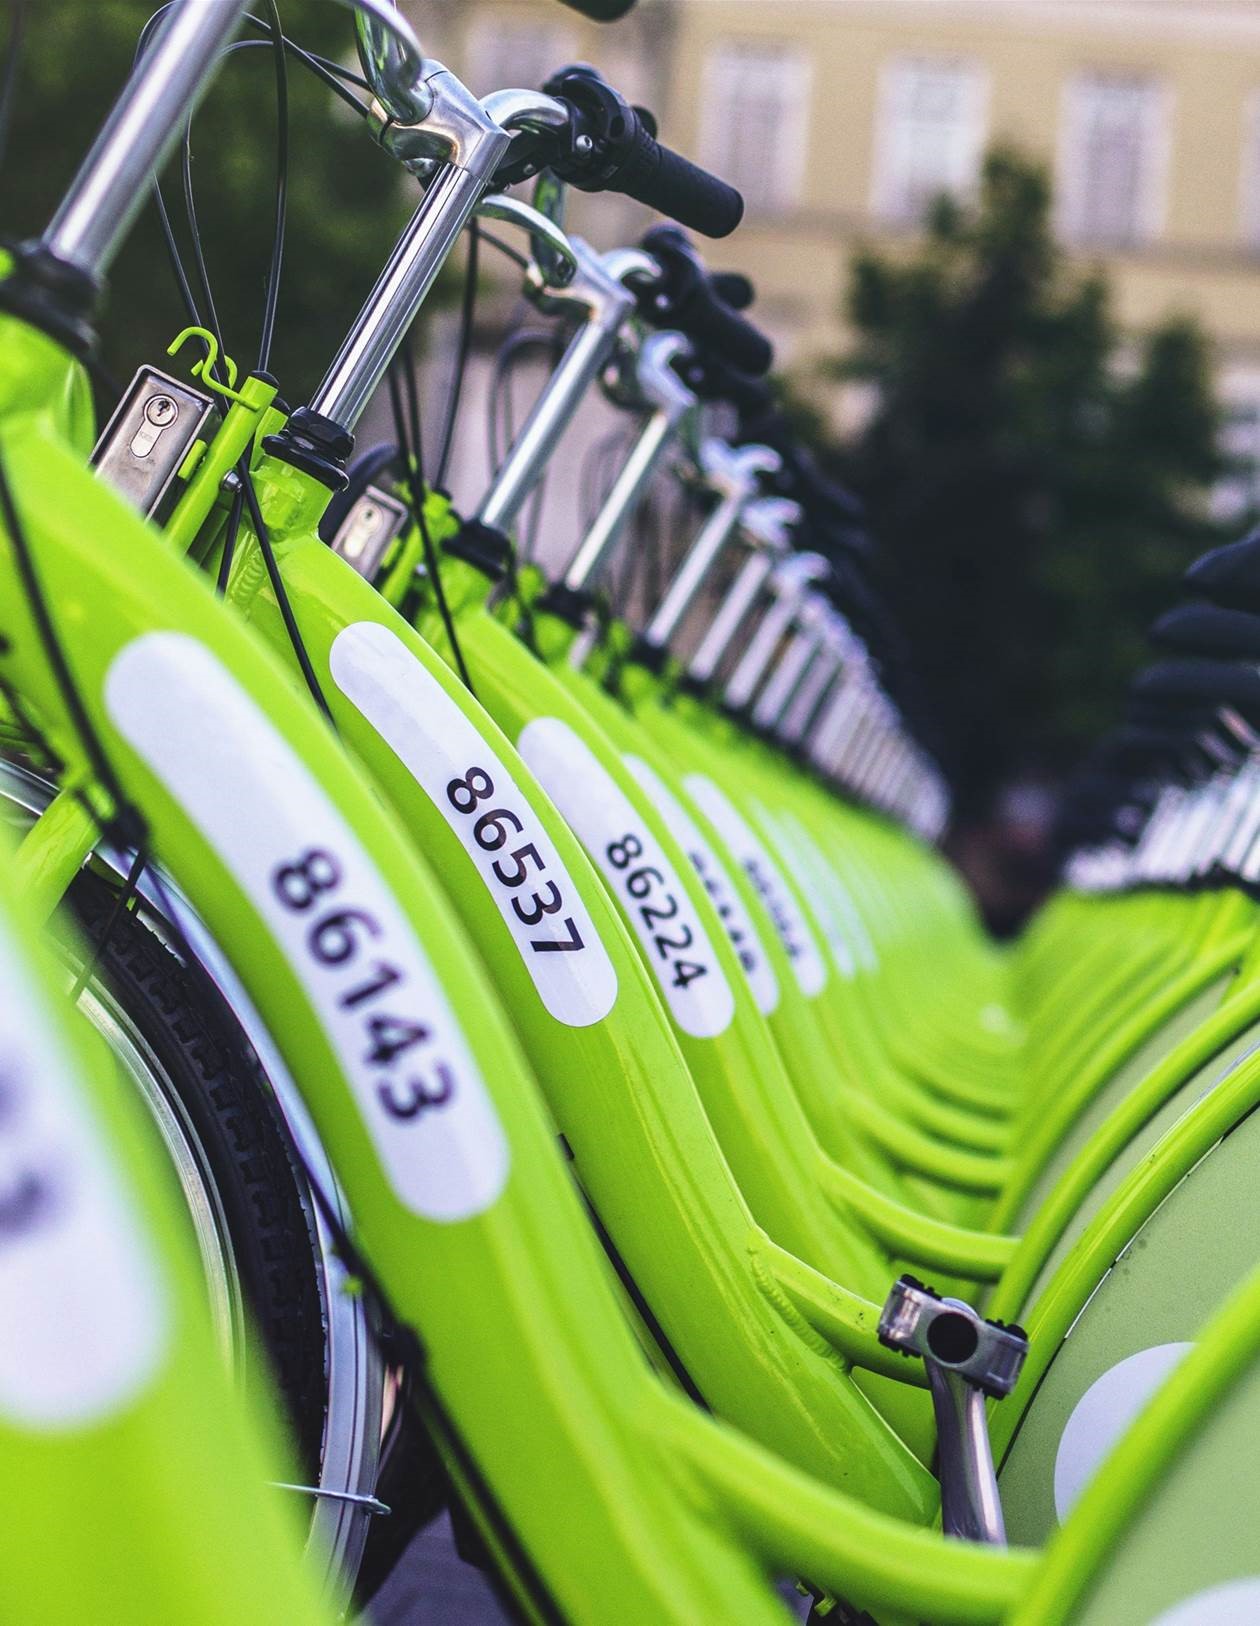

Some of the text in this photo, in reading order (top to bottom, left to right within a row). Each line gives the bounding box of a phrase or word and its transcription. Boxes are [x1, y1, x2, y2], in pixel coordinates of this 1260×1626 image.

[446, 767, 585, 953] 86537
[606, 833, 708, 989] 86224
[272, 848, 456, 1122] 86143
